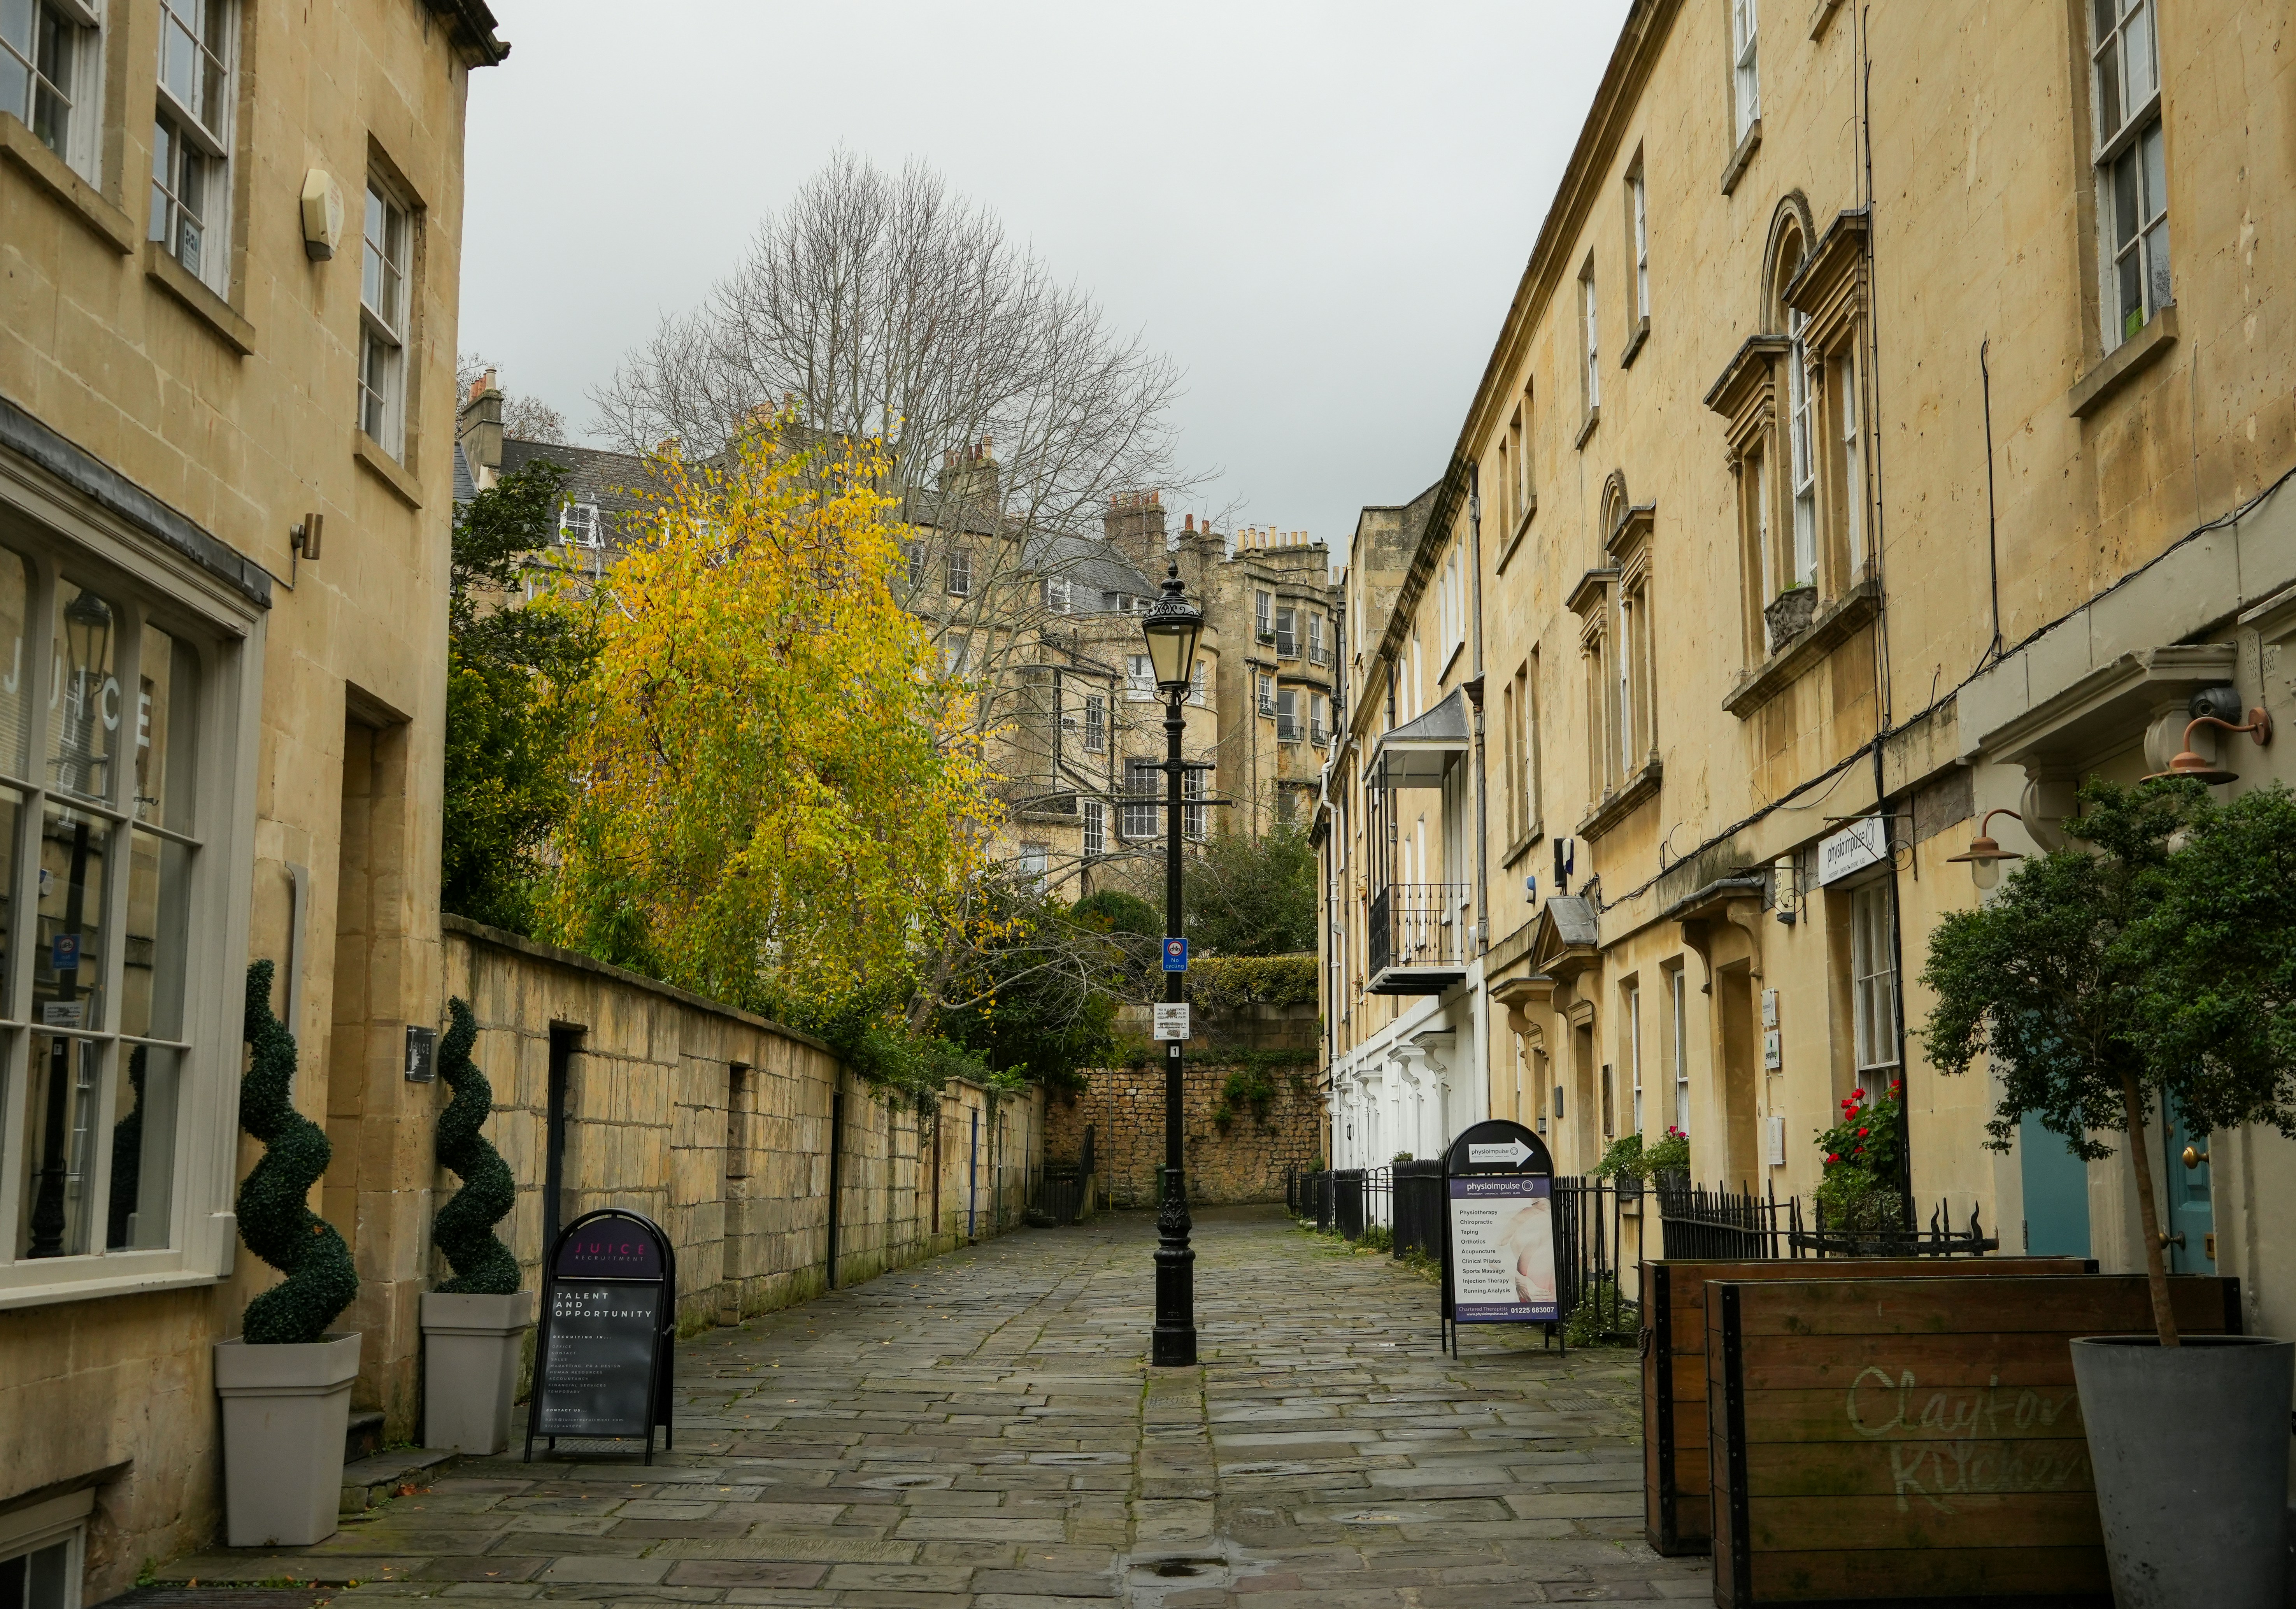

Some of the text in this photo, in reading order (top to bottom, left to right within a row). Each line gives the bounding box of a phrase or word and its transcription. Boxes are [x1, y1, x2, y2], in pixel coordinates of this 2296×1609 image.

[1828, 828, 1865, 868] physioimpulse
[1467, 1182, 1520, 1191] physioimpulse
[575, 1243, 644, 1254] JUICE
